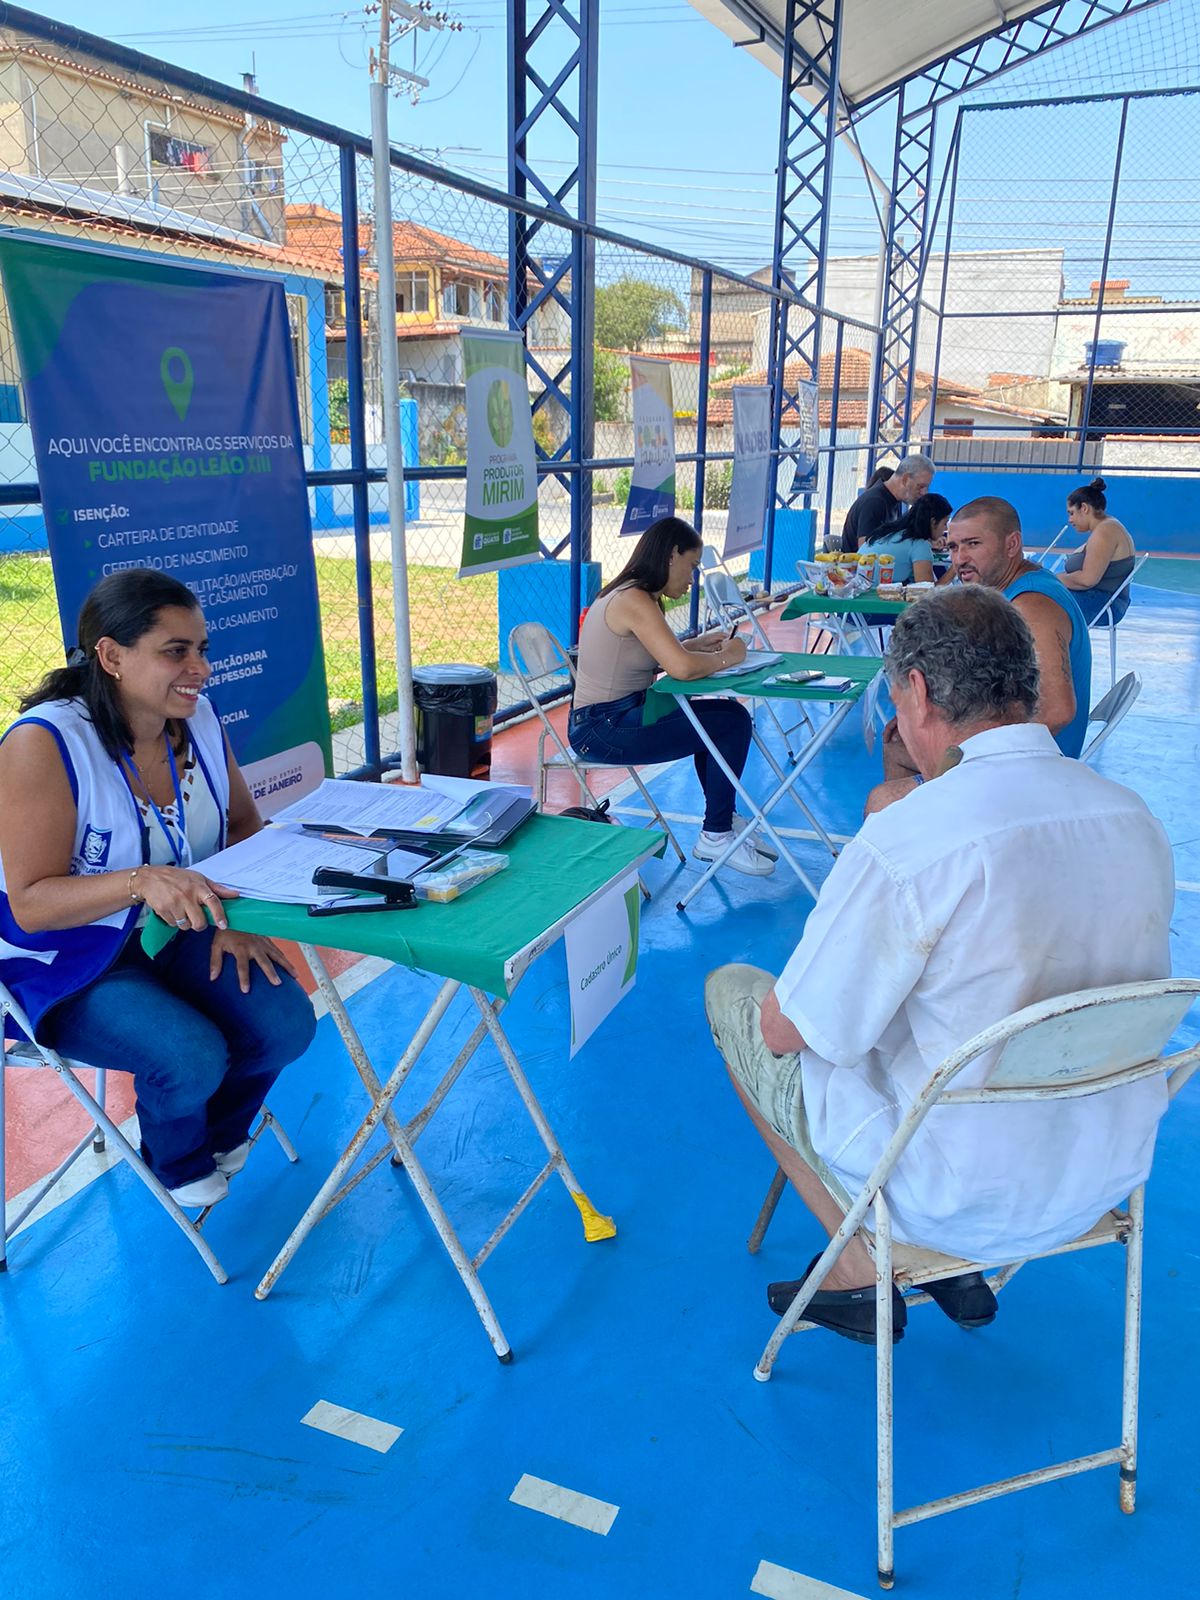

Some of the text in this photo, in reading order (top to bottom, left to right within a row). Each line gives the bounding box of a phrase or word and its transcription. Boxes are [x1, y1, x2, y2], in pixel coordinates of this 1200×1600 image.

[48, 434, 294, 458] AQUI VOCÊ ENCONTRA OS SERVIÇOS DA
[88, 451, 272, 484] FUNDAÇÃO LEÃO XIII
[484, 464, 524, 480] PRODUTOR
[482, 478, 524, 506] MIRIM
[73, 504, 130, 522] ISENÇÃO:
[98, 520, 240, 548] CARTEIRA DE IDENTIDADE
[165, 554, 180, 568] DE
[181, 545, 249, 566] NASCIMENTO
[185, 564, 298, 594] BILITAÇÃO/AVERBAÇÃO/
[200, 583, 268, 608] E CASAMENTO
[218, 606, 278, 630] CASAMENTO
[244, 650, 268, 664] PARA
[208, 664, 264, 688] DE PESSOAS
[220, 709, 250, 725] OCIAL
[248, 779, 267, 790] ERNO
[280, 765, 302, 779] ESTADO
[254, 772, 302, 800] DE JANEIRO
[580, 944, 622, 991] Cadastro Único
